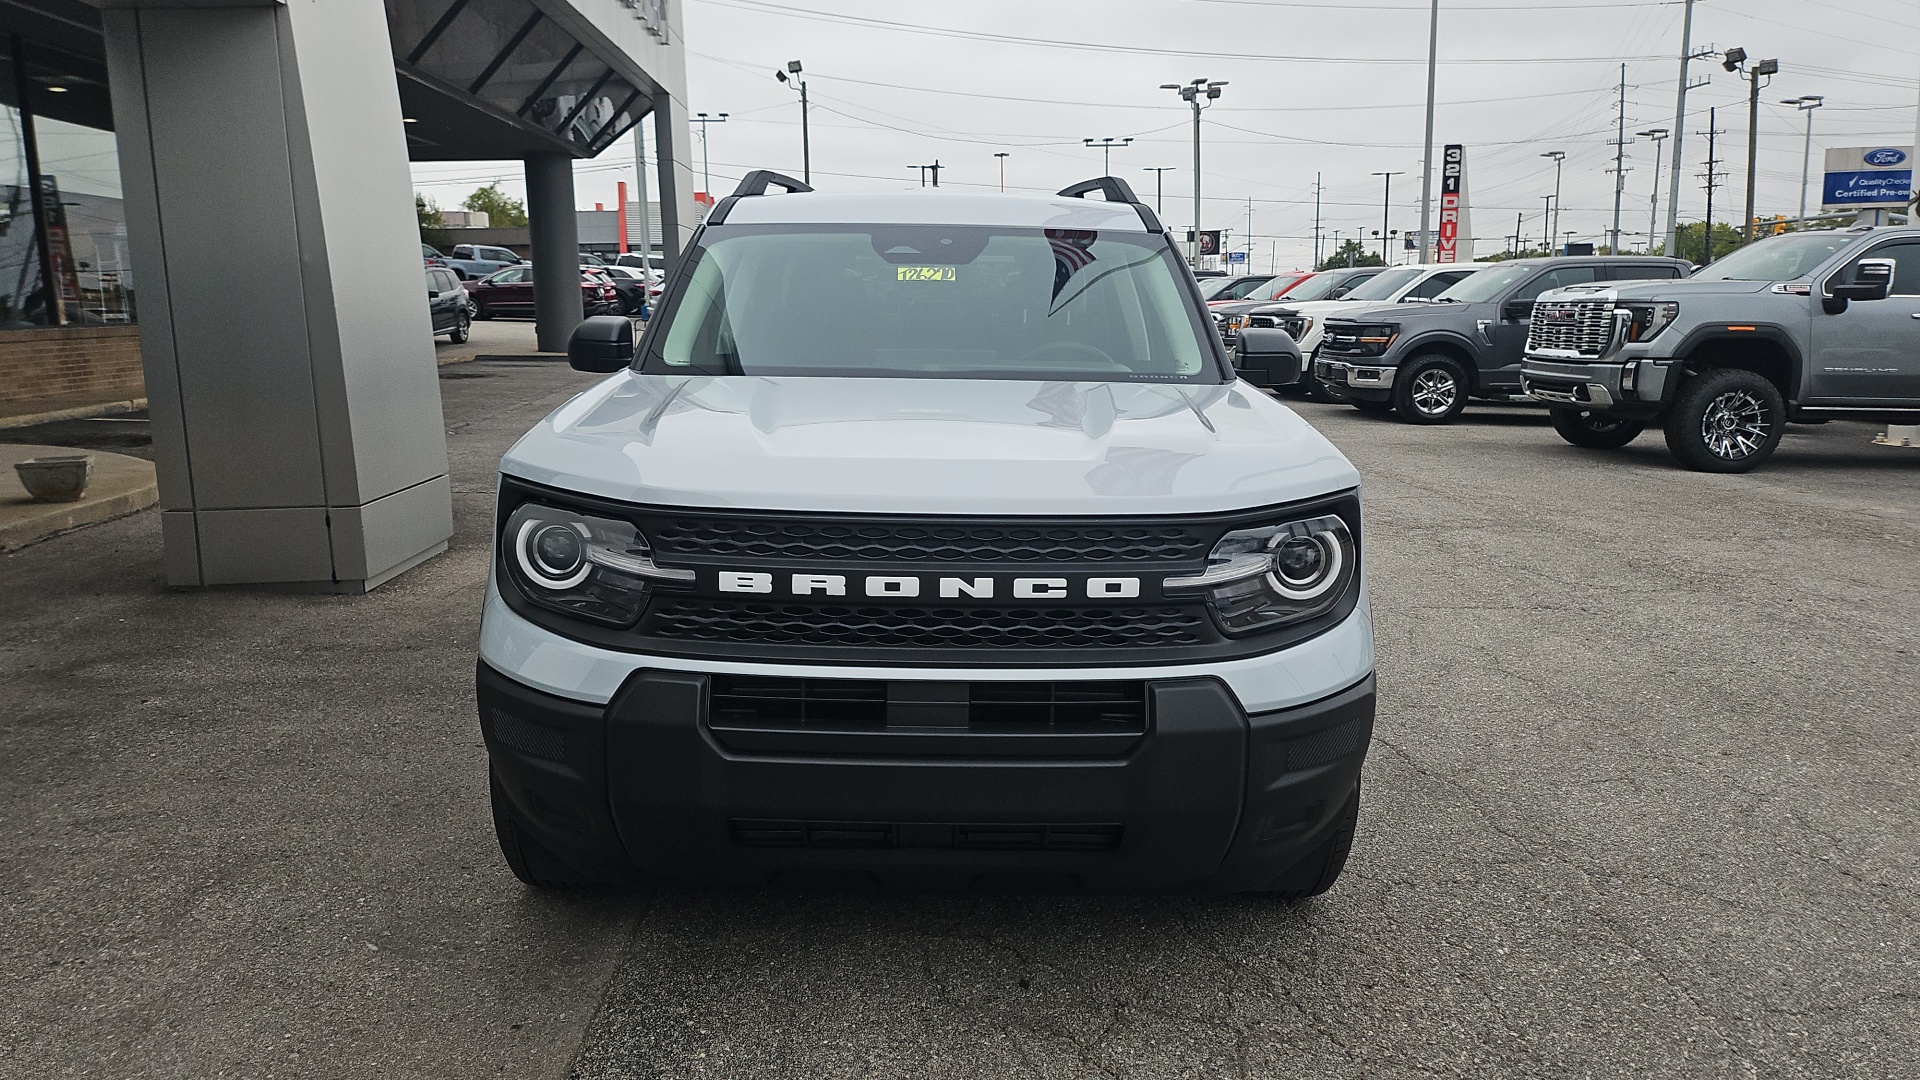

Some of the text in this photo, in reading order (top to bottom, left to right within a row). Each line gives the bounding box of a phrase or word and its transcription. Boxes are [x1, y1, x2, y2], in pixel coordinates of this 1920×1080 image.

[1874, 152, 1899, 163] Ford
[1835, 189, 1877, 198] Certified
[1440, 148, 1461, 262] 321 DRIVE
[718, 571, 1140, 599] BRONCO
